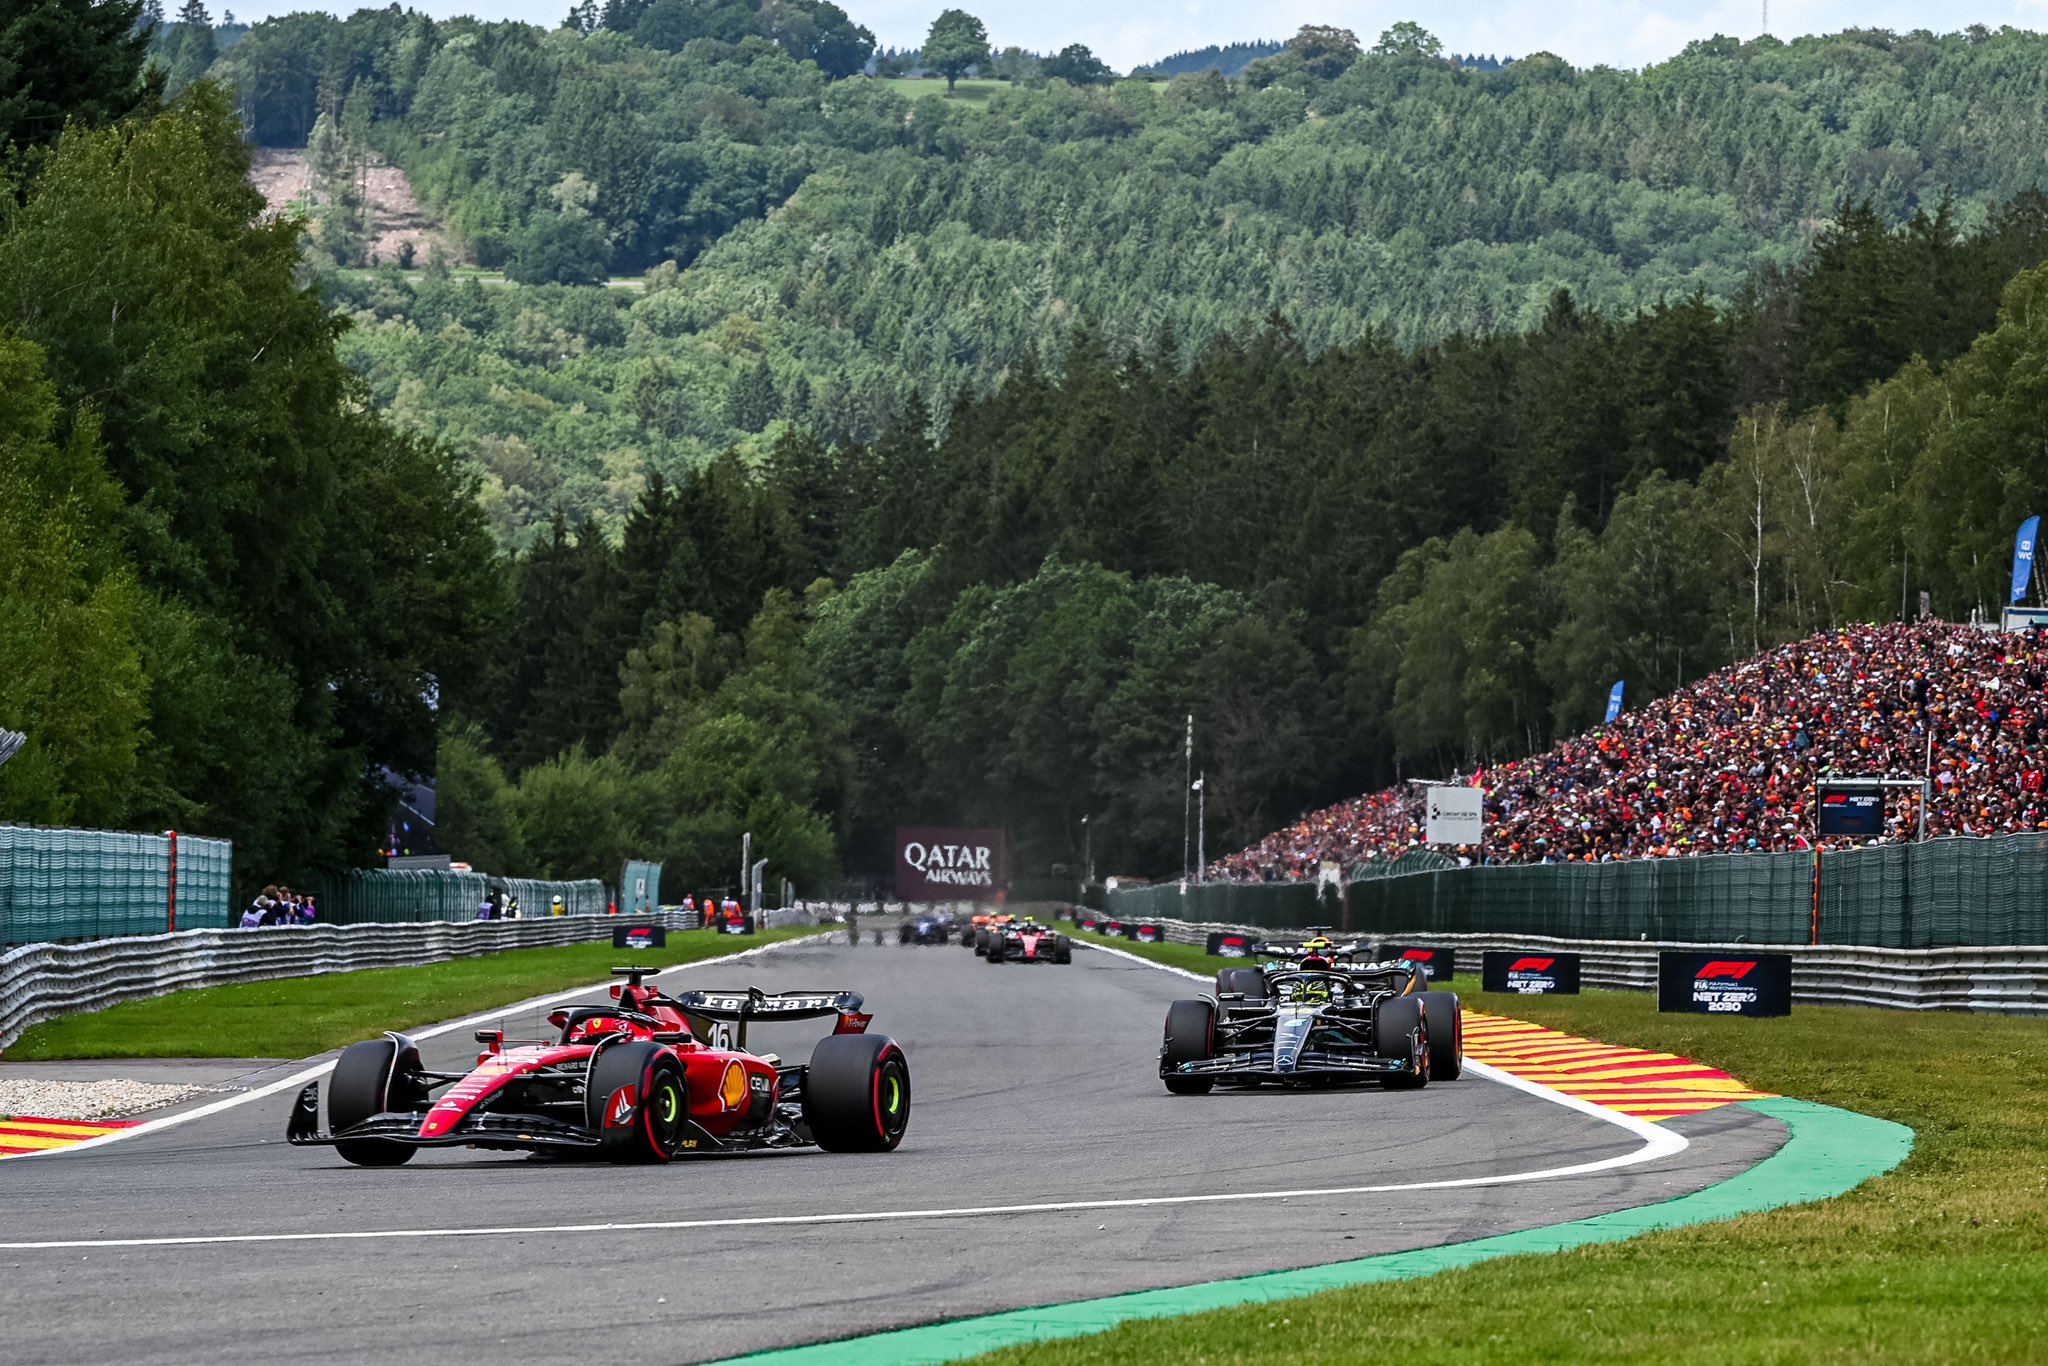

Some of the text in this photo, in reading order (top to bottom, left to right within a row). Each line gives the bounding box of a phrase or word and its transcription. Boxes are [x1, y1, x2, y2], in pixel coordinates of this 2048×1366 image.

[2018, 551, 2033, 560] WC
[904, 842, 991, 871] QATAR
[926, 867, 992, 887] AIRWAYS
[1693, 992, 1757, 1003] NET ZERO
[1708, 1002, 1742, 1012] 2030
[708, 1023, 729, 1050] 16
